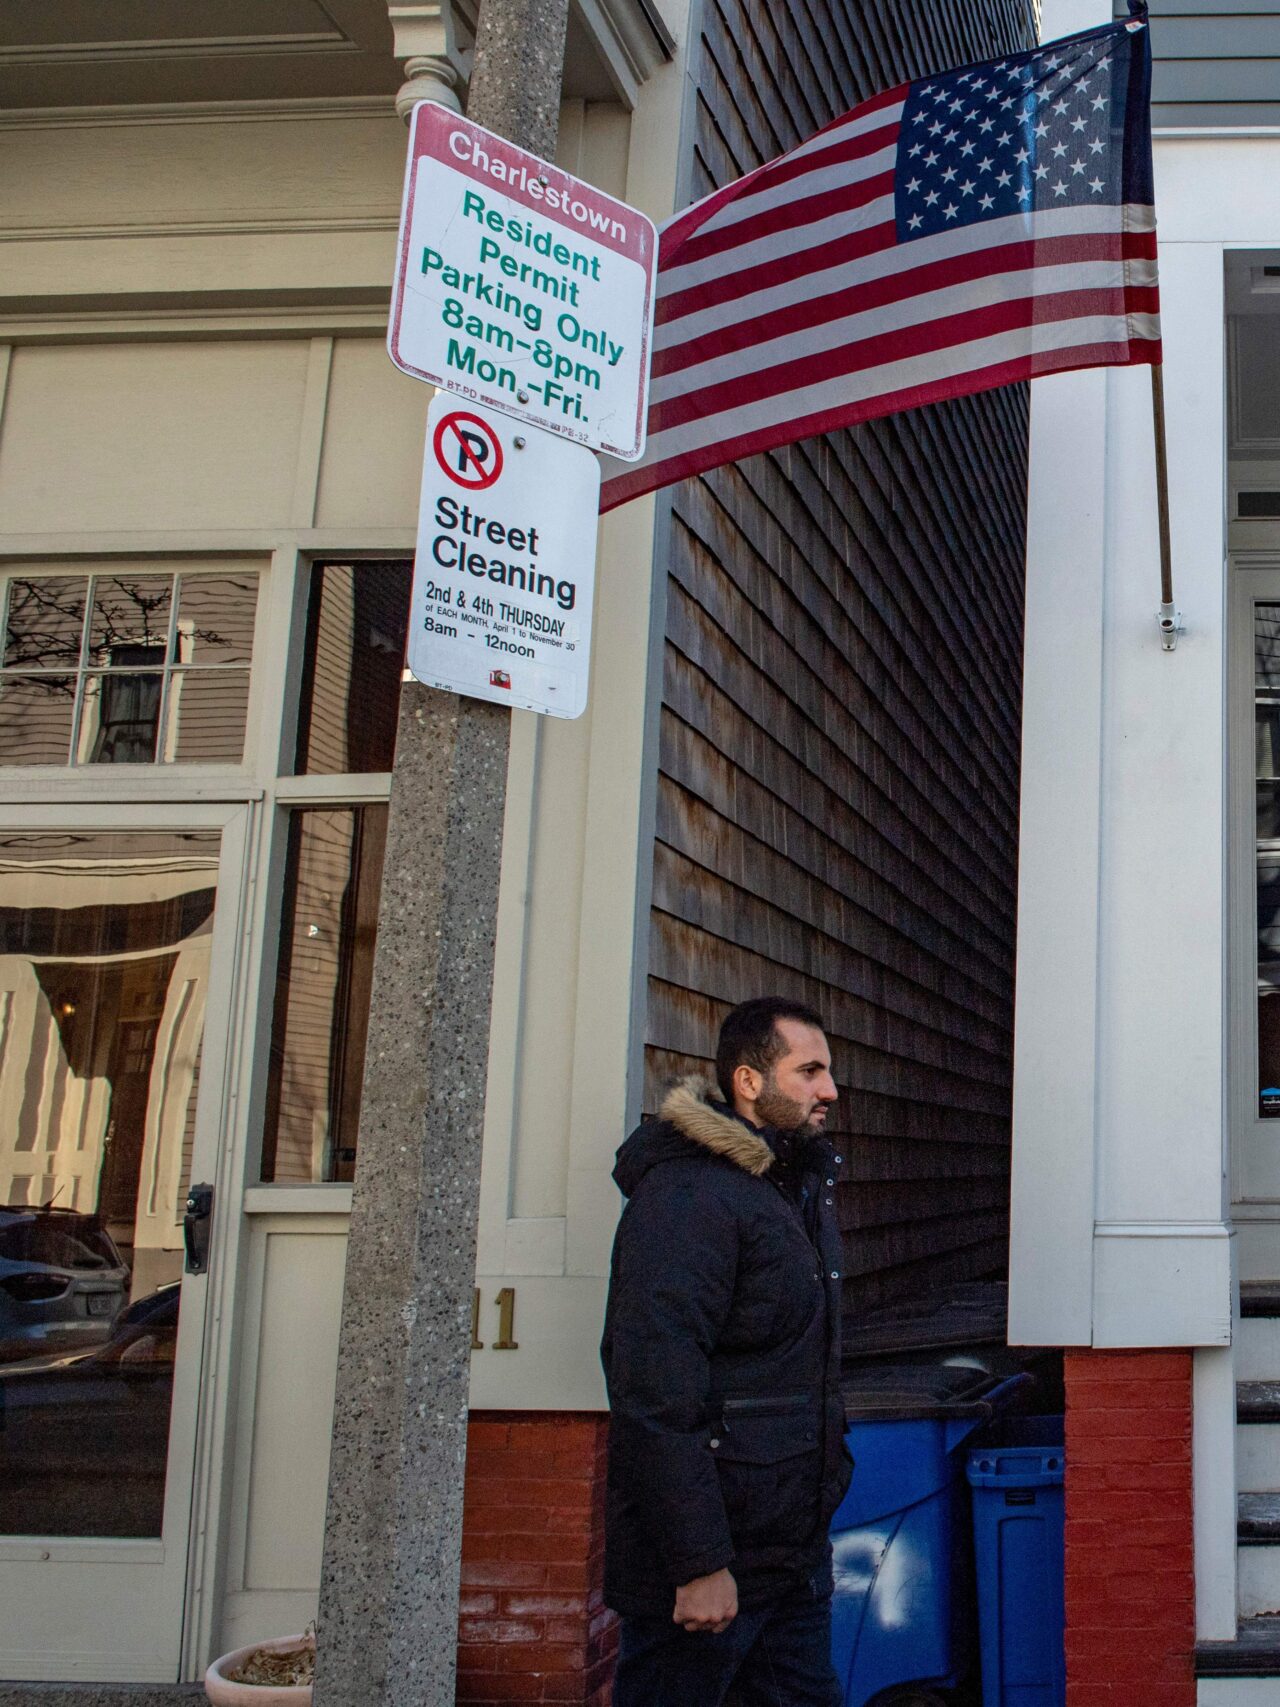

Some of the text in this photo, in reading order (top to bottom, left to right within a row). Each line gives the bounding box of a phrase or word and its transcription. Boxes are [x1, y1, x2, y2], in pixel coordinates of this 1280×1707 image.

[449, 130, 627, 243] Charlestown
[462, 189, 601, 282] Resident
[421, 246, 625, 366] Parking Only
[479, 237, 579, 308] Permit
[447, 338, 590, 423] Mon-Fri.
[434, 496, 539, 556] Street
[432, 534, 576, 610] Cleaning
[424, 616, 457, 638] 8am
[484, 633, 535, 659] 12noon
[425, 604, 434, 612] of
[437, 606, 458, 619] EACH
[492, 622, 509, 633] April
[529, 632, 563, 648] November
[565, 642, 576, 651] 30
[427, 581, 566, 638] 2nd & 4th THURSDAY
